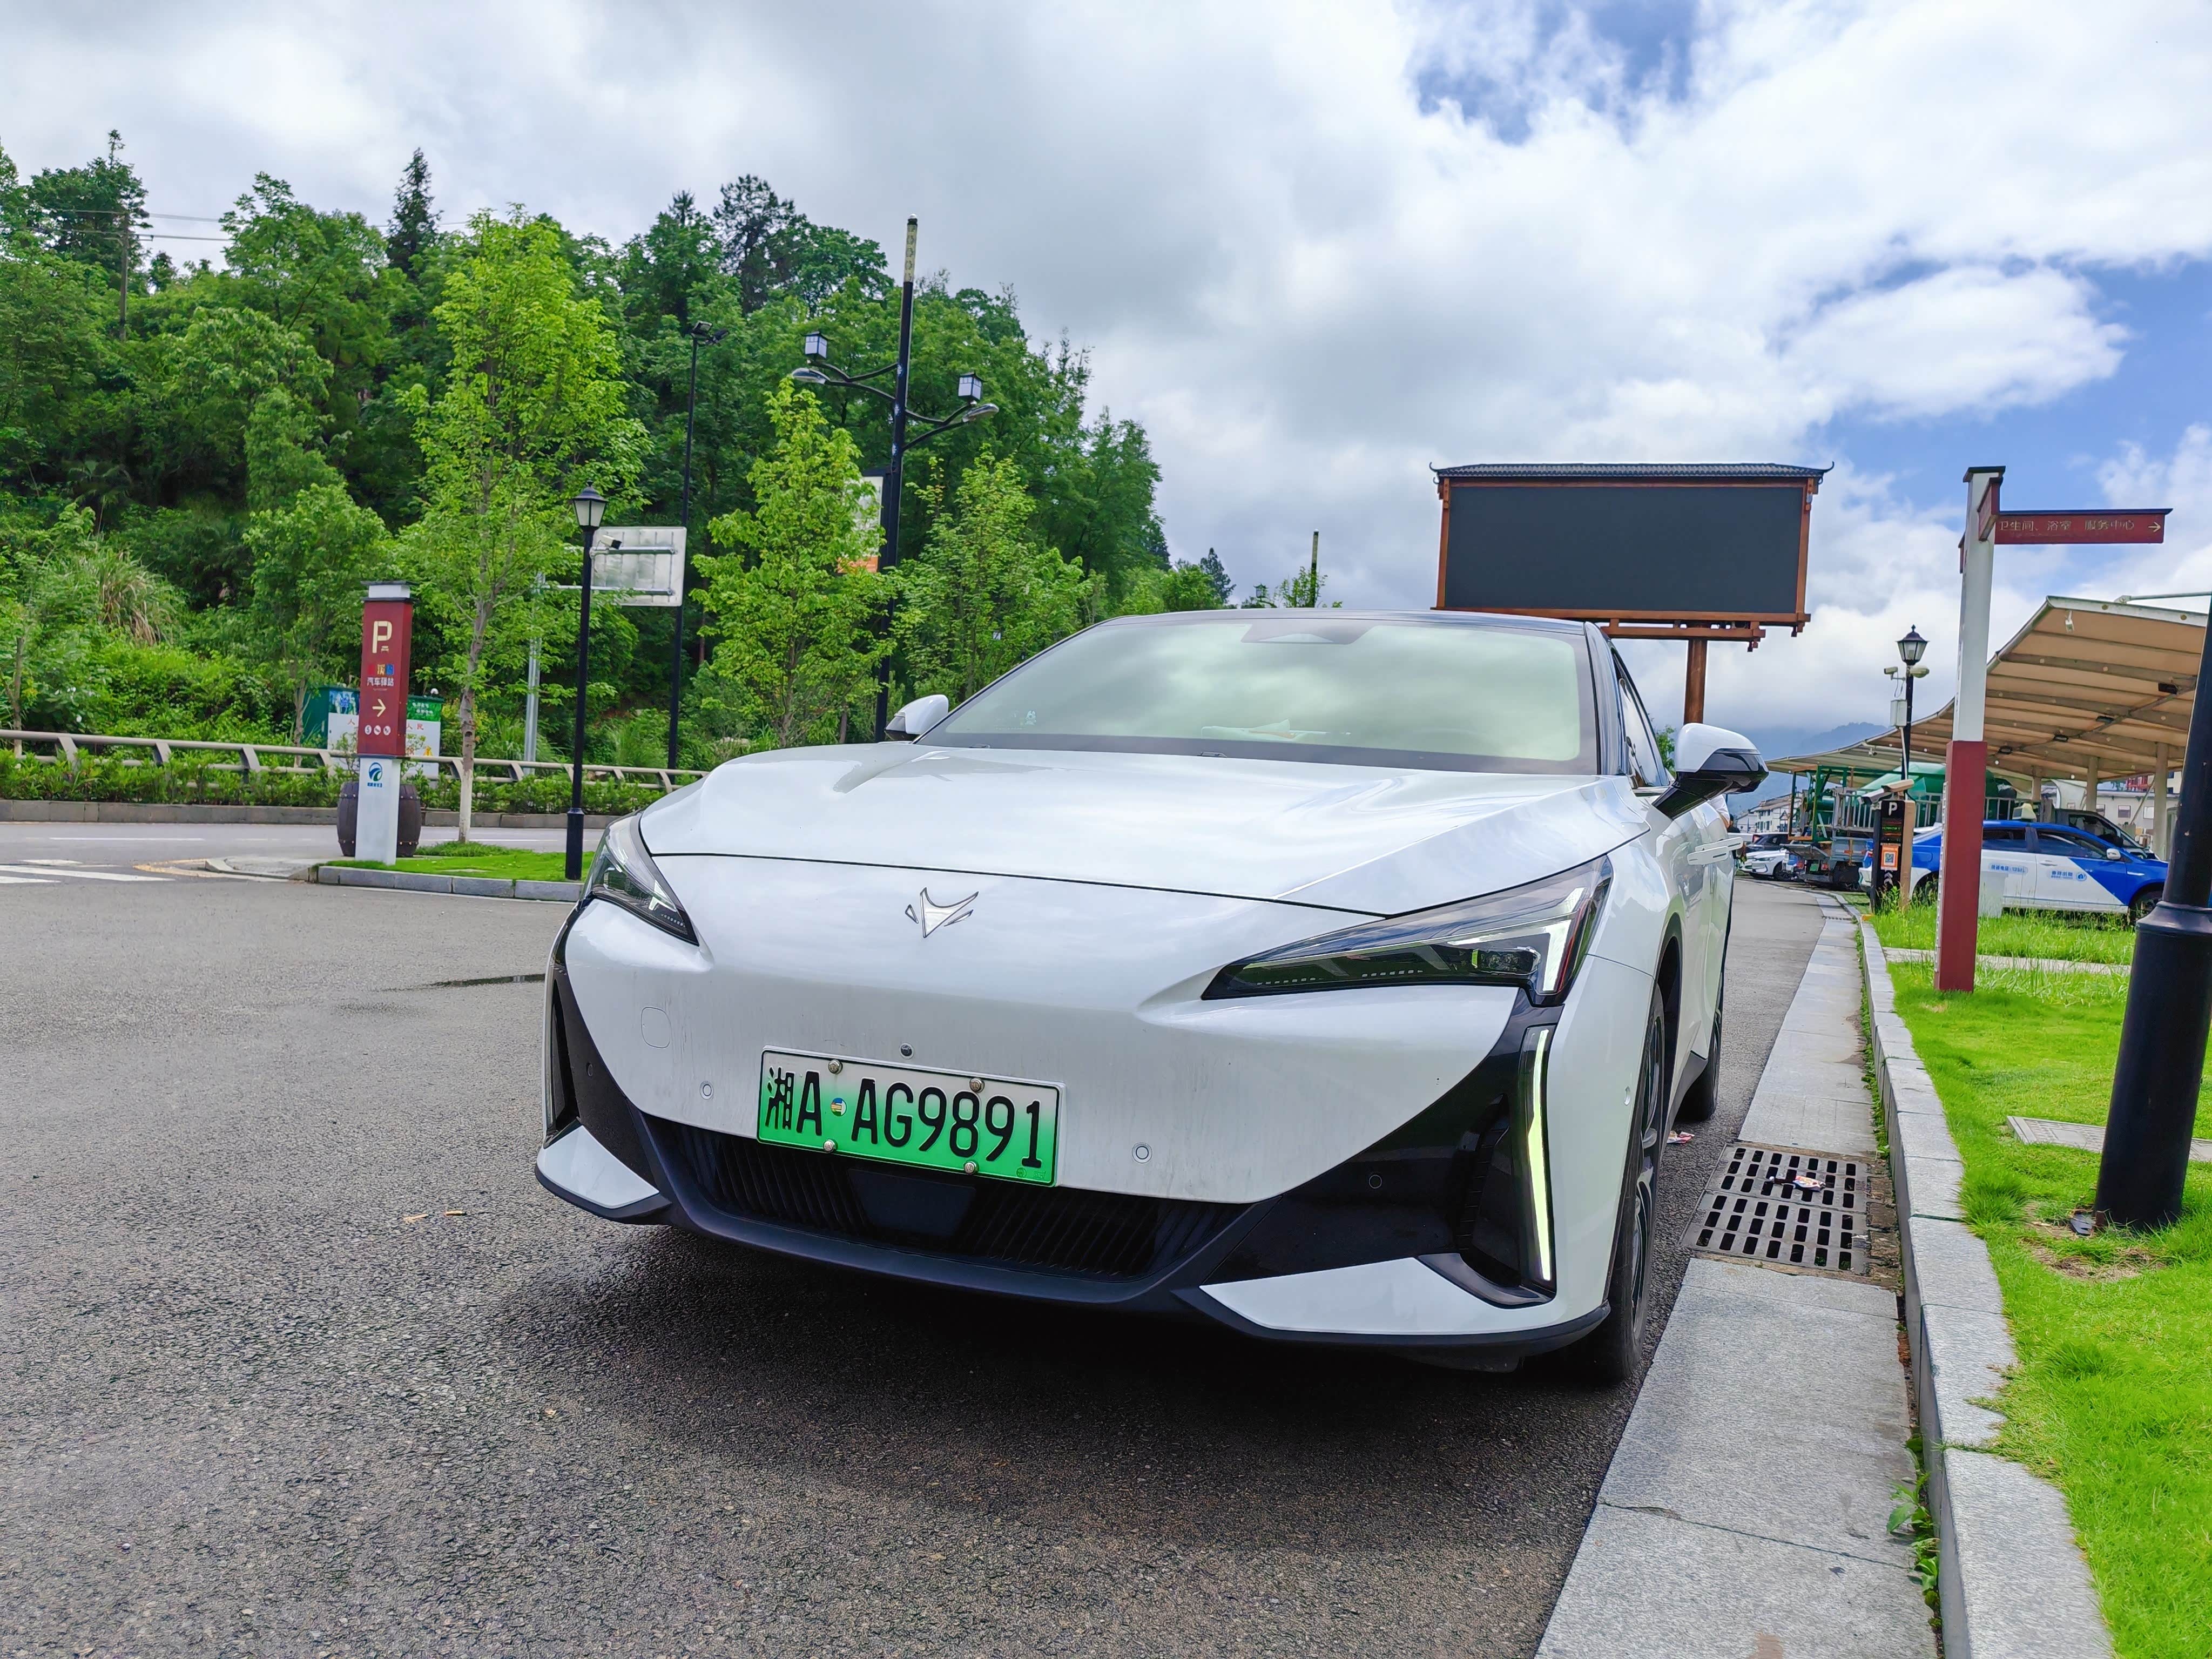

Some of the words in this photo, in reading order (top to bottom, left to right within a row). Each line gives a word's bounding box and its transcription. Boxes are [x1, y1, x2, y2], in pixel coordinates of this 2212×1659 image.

[2085, 519, 2134, 530] 服务中心
[372, 621, 392, 653] P
[1888, 801, 1898, 816] P
[765, 1067, 822, 1136] 湘A
[851, 1077, 1042, 1169] AG9891
